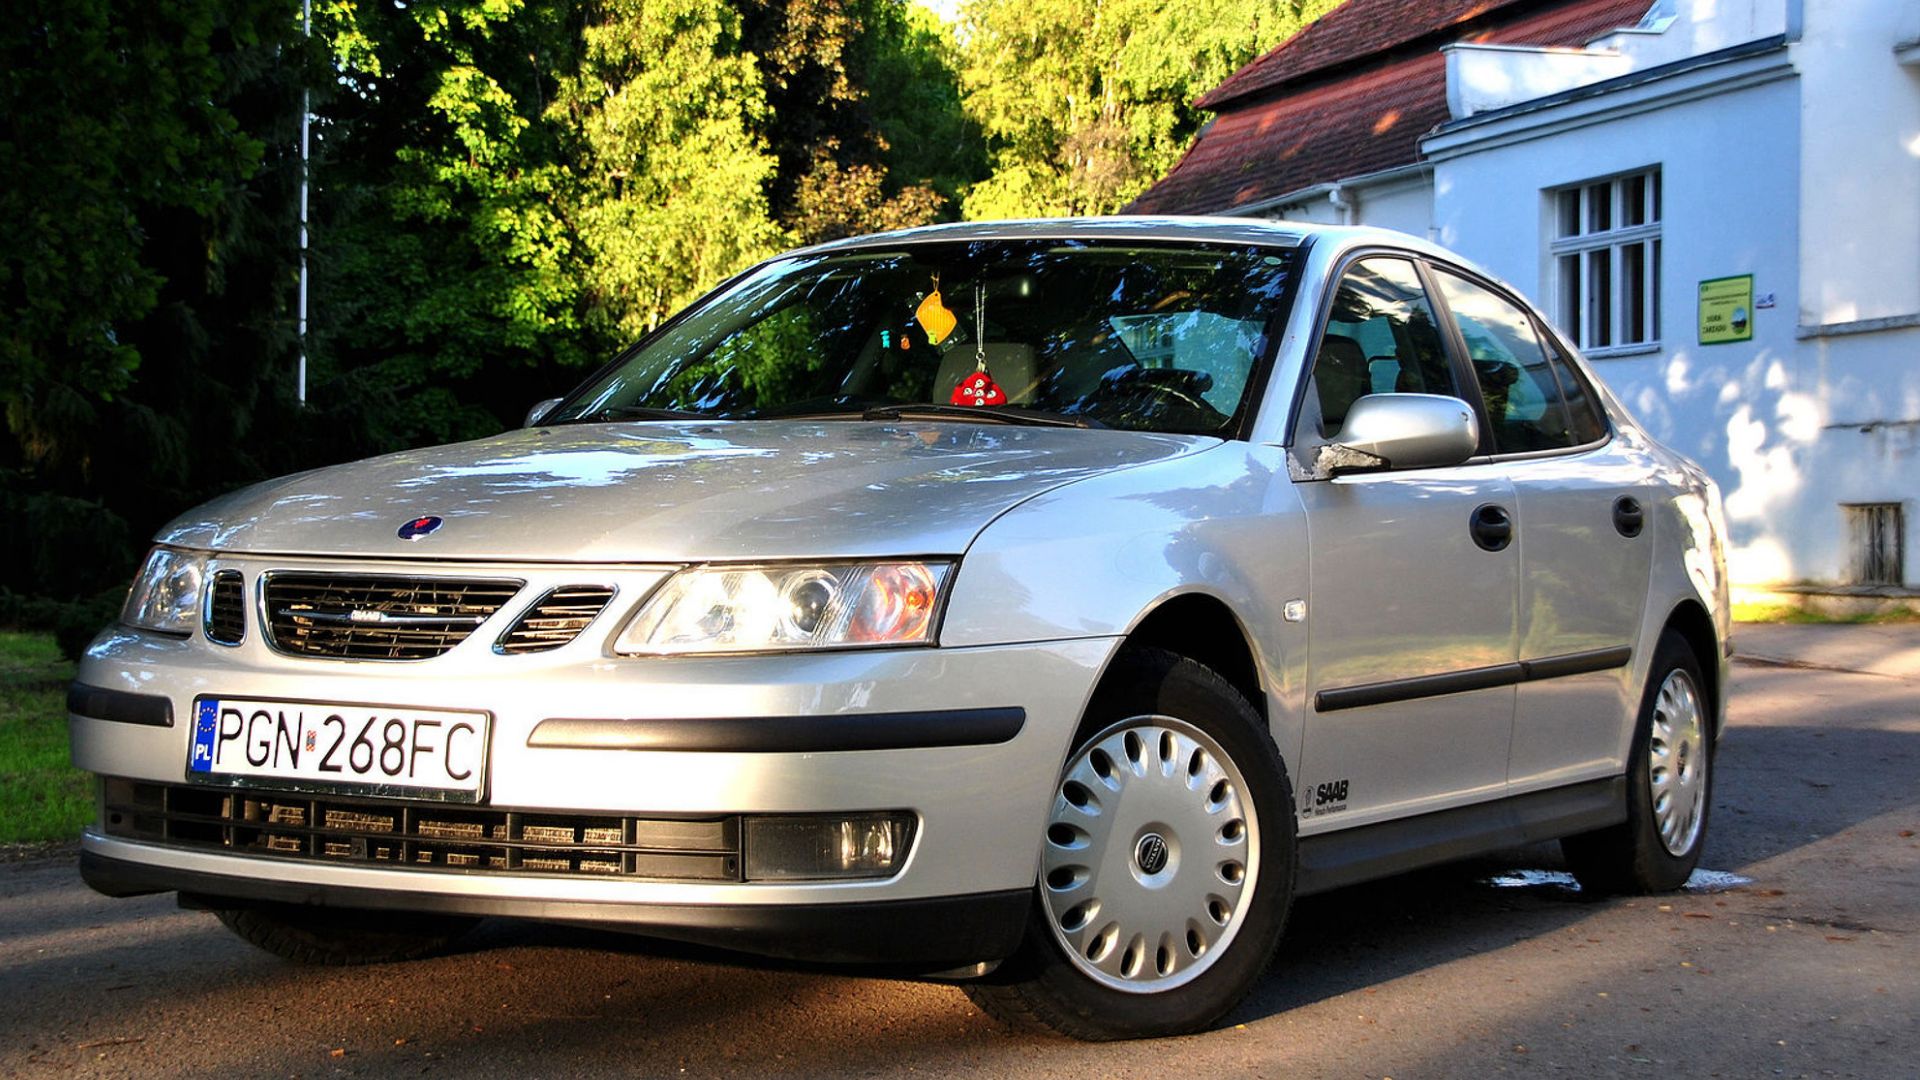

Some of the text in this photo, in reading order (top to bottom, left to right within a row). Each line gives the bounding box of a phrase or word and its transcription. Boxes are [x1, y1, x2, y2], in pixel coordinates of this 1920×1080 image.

[195, 743, 211, 760] PL
[216, 708, 475, 781] PGN 268FC
[1316, 780, 1349, 806] SAAB
[1145, 838, 1162, 869] VOLVO
